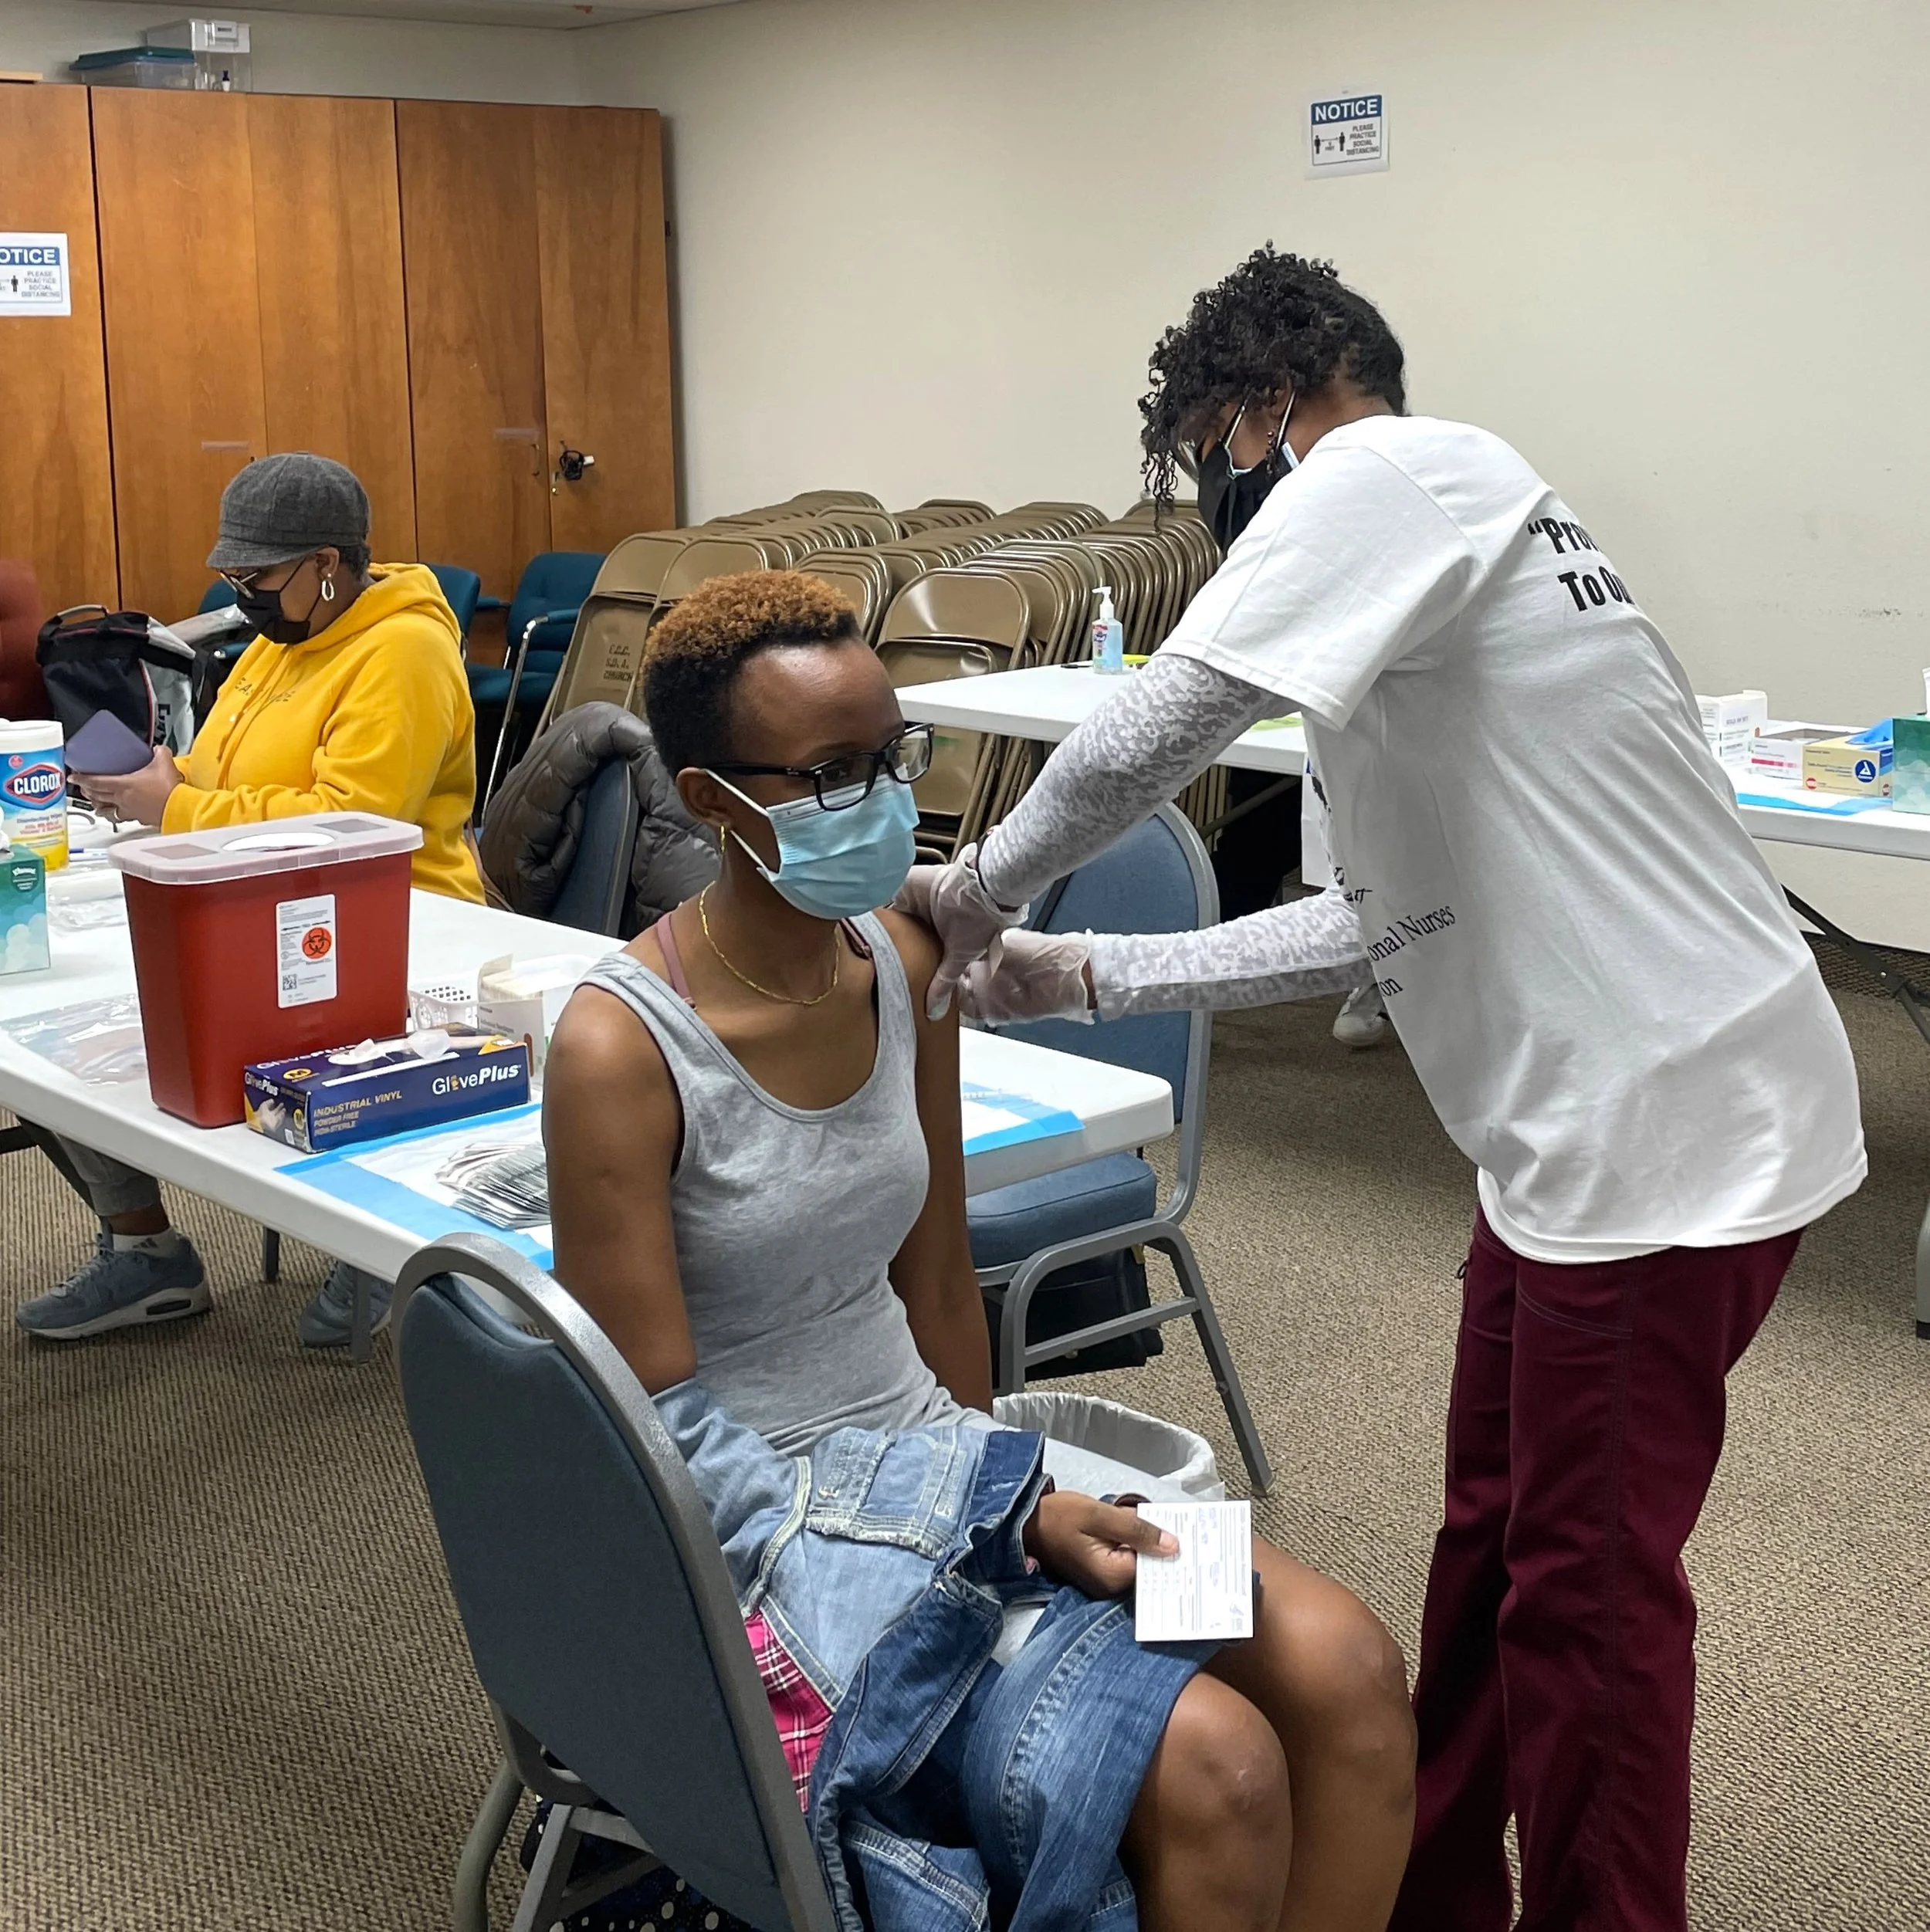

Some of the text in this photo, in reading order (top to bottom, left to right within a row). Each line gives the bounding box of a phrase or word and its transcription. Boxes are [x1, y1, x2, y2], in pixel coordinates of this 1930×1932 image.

[1315, 99, 1378, 122] NOTICE
[1349, 130, 1376, 140] PRACTICE
[1353, 123, 1373, 132] PLEASE
[1346, 146, 1380, 156] DISTANCING
[1353, 139, 1373, 147] SOCIAL
[1557, 570, 1606, 612] To
[14, 773, 61, 795] CLOROX
[1396, 905, 1455, 941] Nurses
[313, 1091, 402, 1117] INDUSTRIAL VINYL
